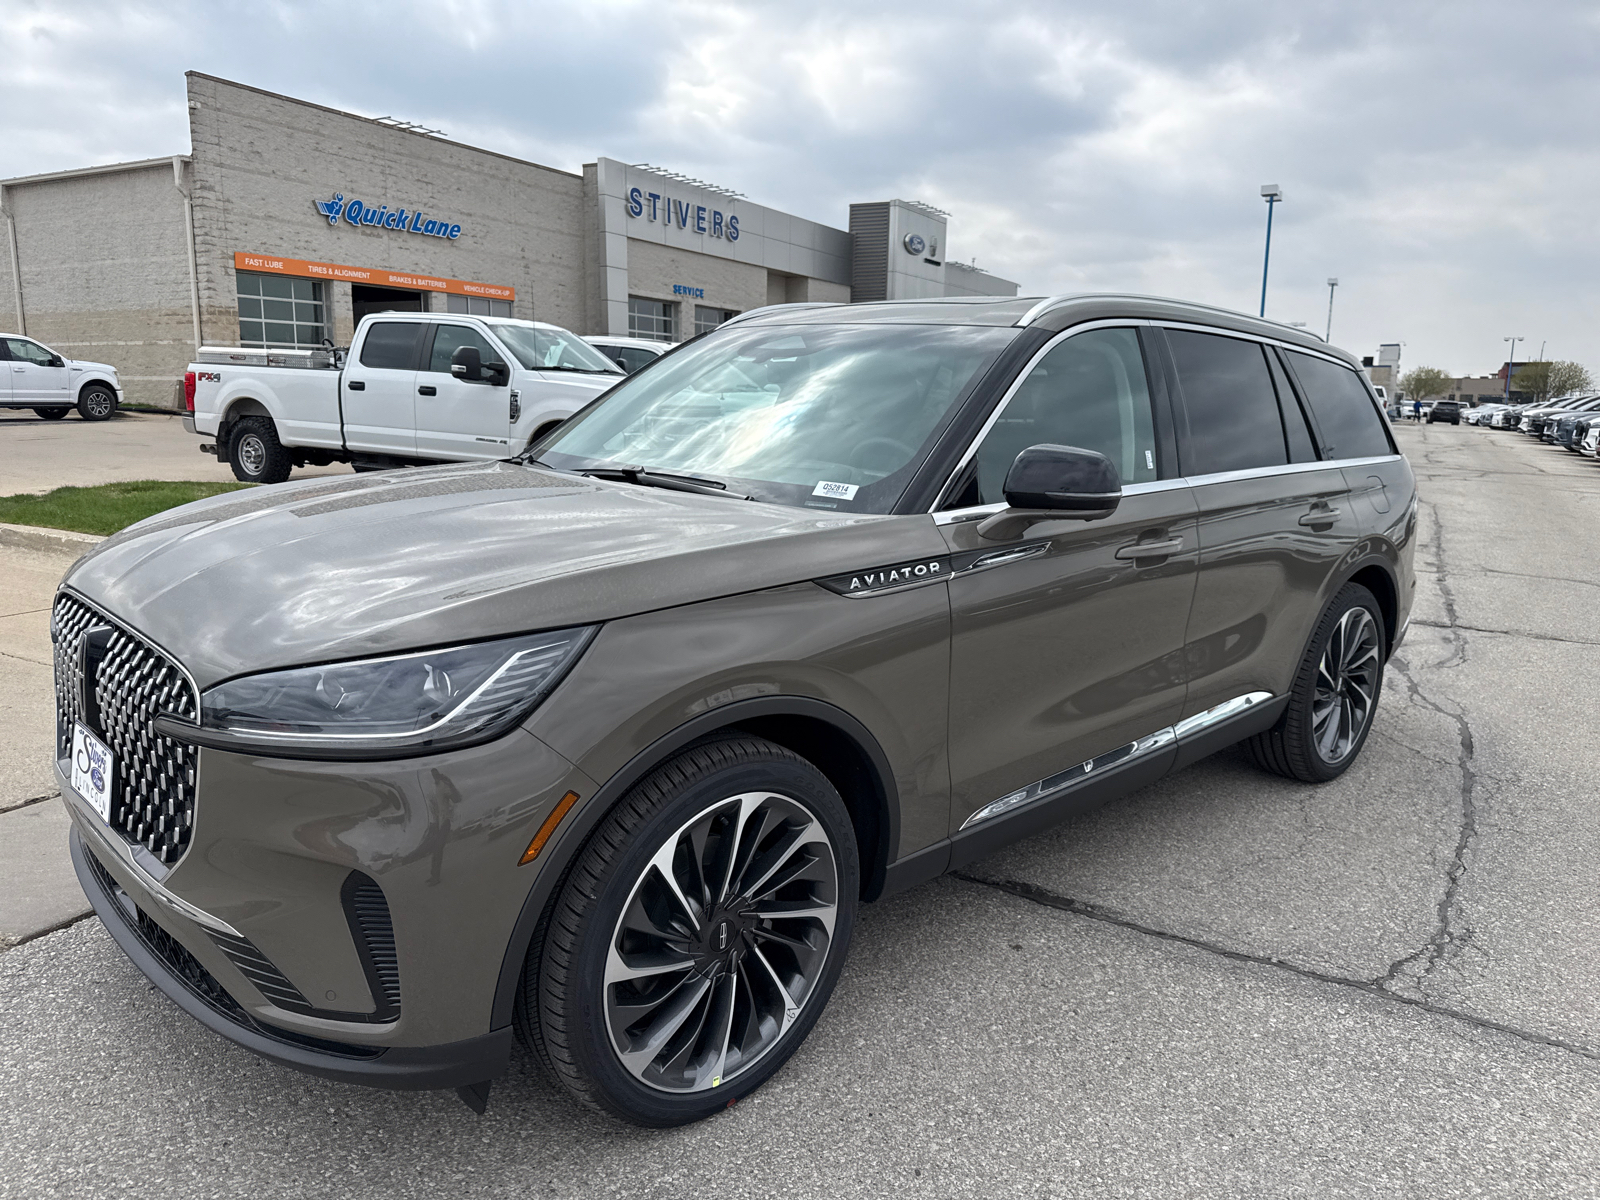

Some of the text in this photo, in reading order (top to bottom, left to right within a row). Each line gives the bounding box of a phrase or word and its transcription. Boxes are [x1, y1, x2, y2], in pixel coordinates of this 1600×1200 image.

[345, 199, 462, 240] Quick Lane
[627, 187, 740, 242] STIVERS
[245, 257, 284, 269] FAST LUBE
[308, 265, 327, 275] TIRES
[334, 268, 371, 279] ALIGNMENT
[388, 275, 412, 285] BRAKES
[418, 279, 447, 289] BATTERIES
[463, 284, 511, 297] VEHICLE CHECK-UP
[672, 284, 705, 299] SERVICE
[198, 372, 221, 383] FX4
[850, 562, 940, 590] AVIATOR
